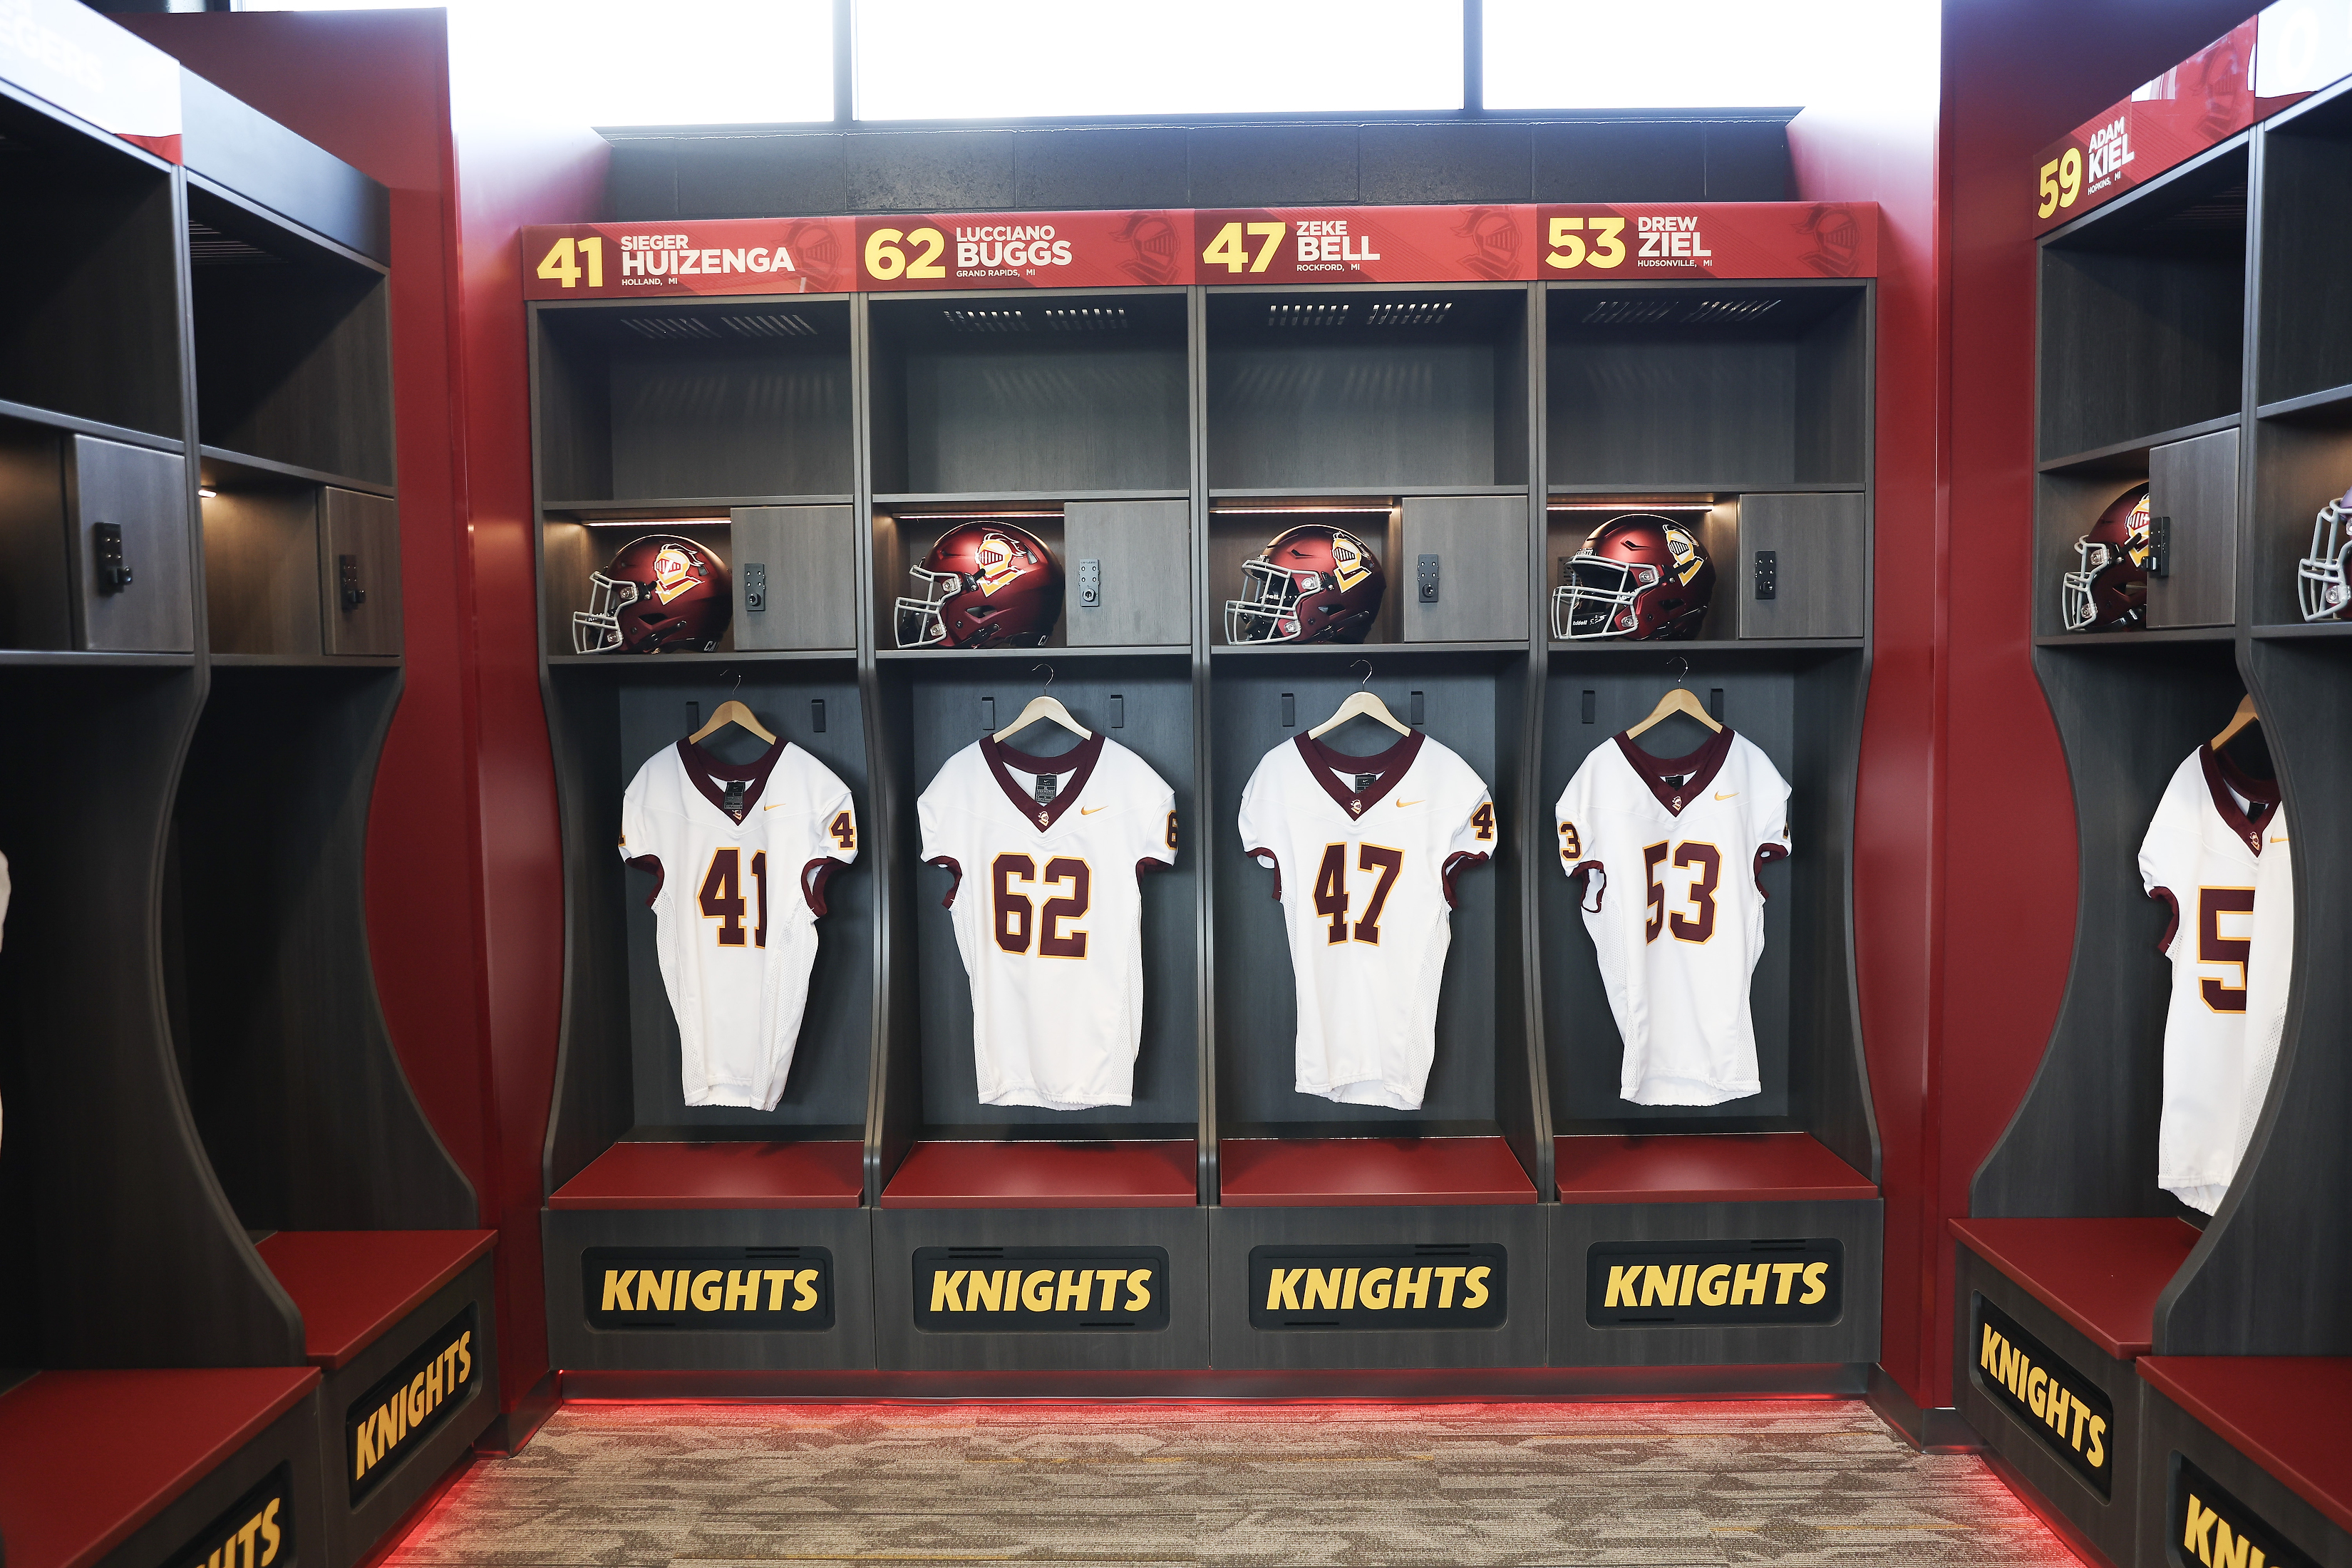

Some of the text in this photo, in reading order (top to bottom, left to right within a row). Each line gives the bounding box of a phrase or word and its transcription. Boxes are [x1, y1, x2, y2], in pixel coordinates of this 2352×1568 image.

[2088, 116, 2125, 154] ADAM
[2088, 133, 2135, 184] KIEL
[2037, 148, 2083, 220] 59
[2087, 171, 2122, 196] HOPKINS, MI
[621, 234, 689, 251] SIEGER
[956, 225, 1056, 243] LUCCIANO
[1296, 220, 1348, 236] ZEKE
[1544, 217, 1626, 269] 53
[1638, 216, 1698, 232] DREW
[1638, 232, 1712, 257] ZIEL
[536, 237, 604, 289] 41
[621, 247, 796, 277] HUIZENGA
[864, 227, 947, 281] 62
[956, 240, 1073, 268] BUGGS
[1202, 222, 1286, 274] 47
[1296, 236, 1381, 262] BELL
[1296, 264, 1345, 272] ROCKFORD,
[1637, 259, 1698, 268] HUDSONVILLE,
[621, 278, 663, 287] HOLLAND,
[988, 269, 1021, 278] RAPIDS,
[828, 810, 856, 851] 4
[1470, 802, 1495, 842] 4
[696, 847, 768, 949] 41
[991, 852, 1092, 961] 62
[1312, 842, 1405, 947] 47
[1642, 840, 1723, 947] 53
[601, 1269, 820, 1312] KNIGHTS
[929, 1269, 1152, 1312] KNIGHTS
[1266, 1266, 1492, 1310] KNIGHTS
[1604, 1262, 1829, 1307] KNIGHTS
[356, 1330, 471, 1481] KNIGHTS
[1980, 1322, 2107, 1468] KNIGHTS
